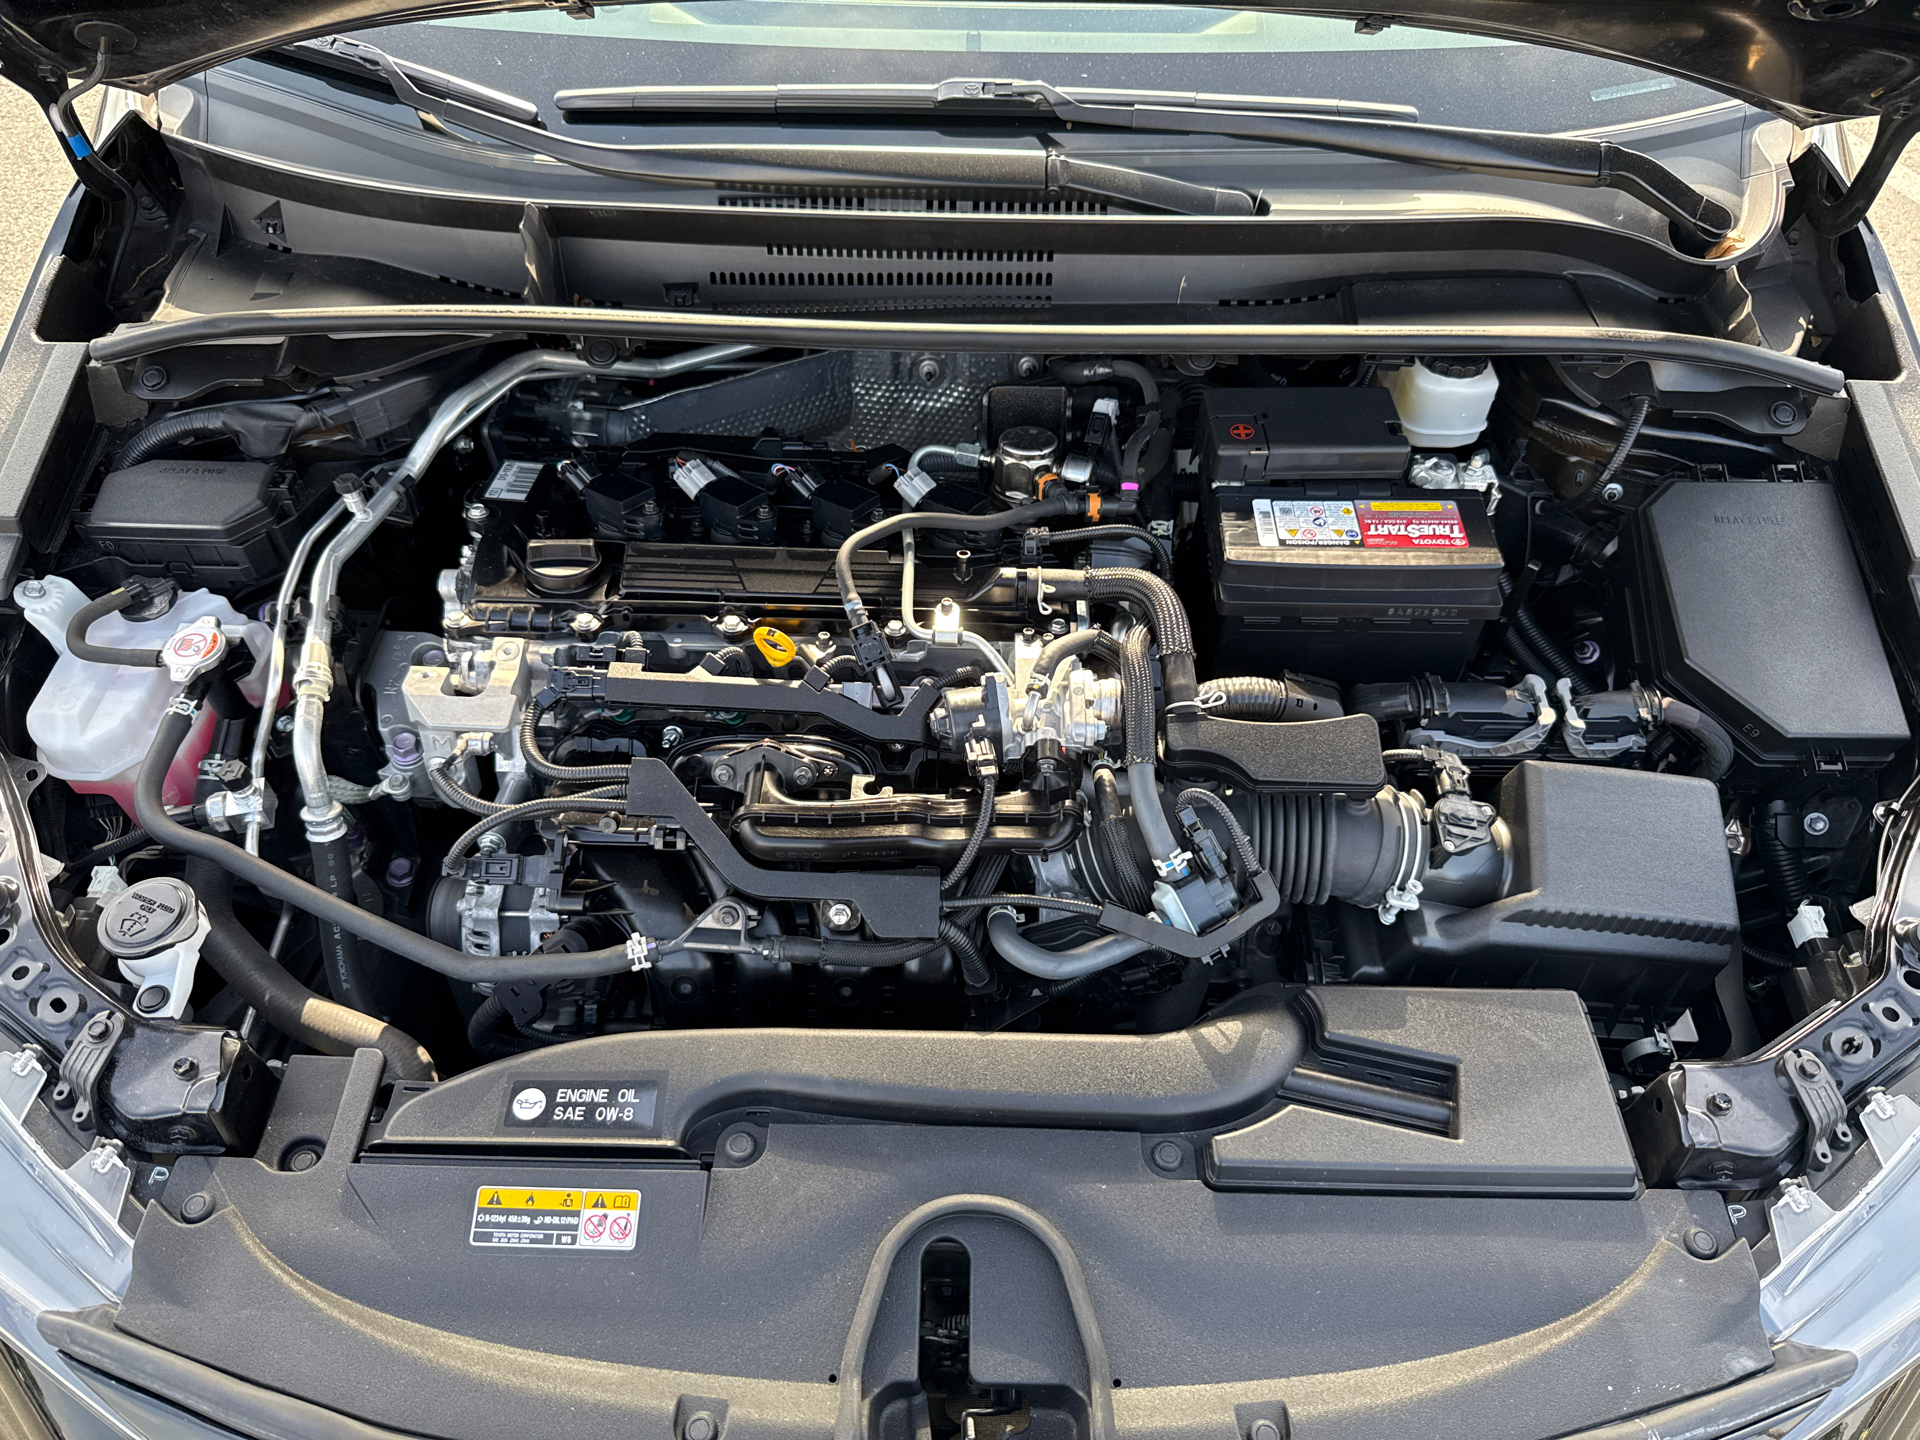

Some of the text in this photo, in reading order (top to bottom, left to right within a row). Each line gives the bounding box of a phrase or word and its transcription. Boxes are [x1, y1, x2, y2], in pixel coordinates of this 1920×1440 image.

[1713, 515, 1744, 525] RELAY
[1757, 515, 1784, 525] FUSE
[335, 944, 348, 983] YOKOHAMA
[555, 1088, 640, 1103] ENGINE OIL
[553, 1106, 586, 1120] SAE
